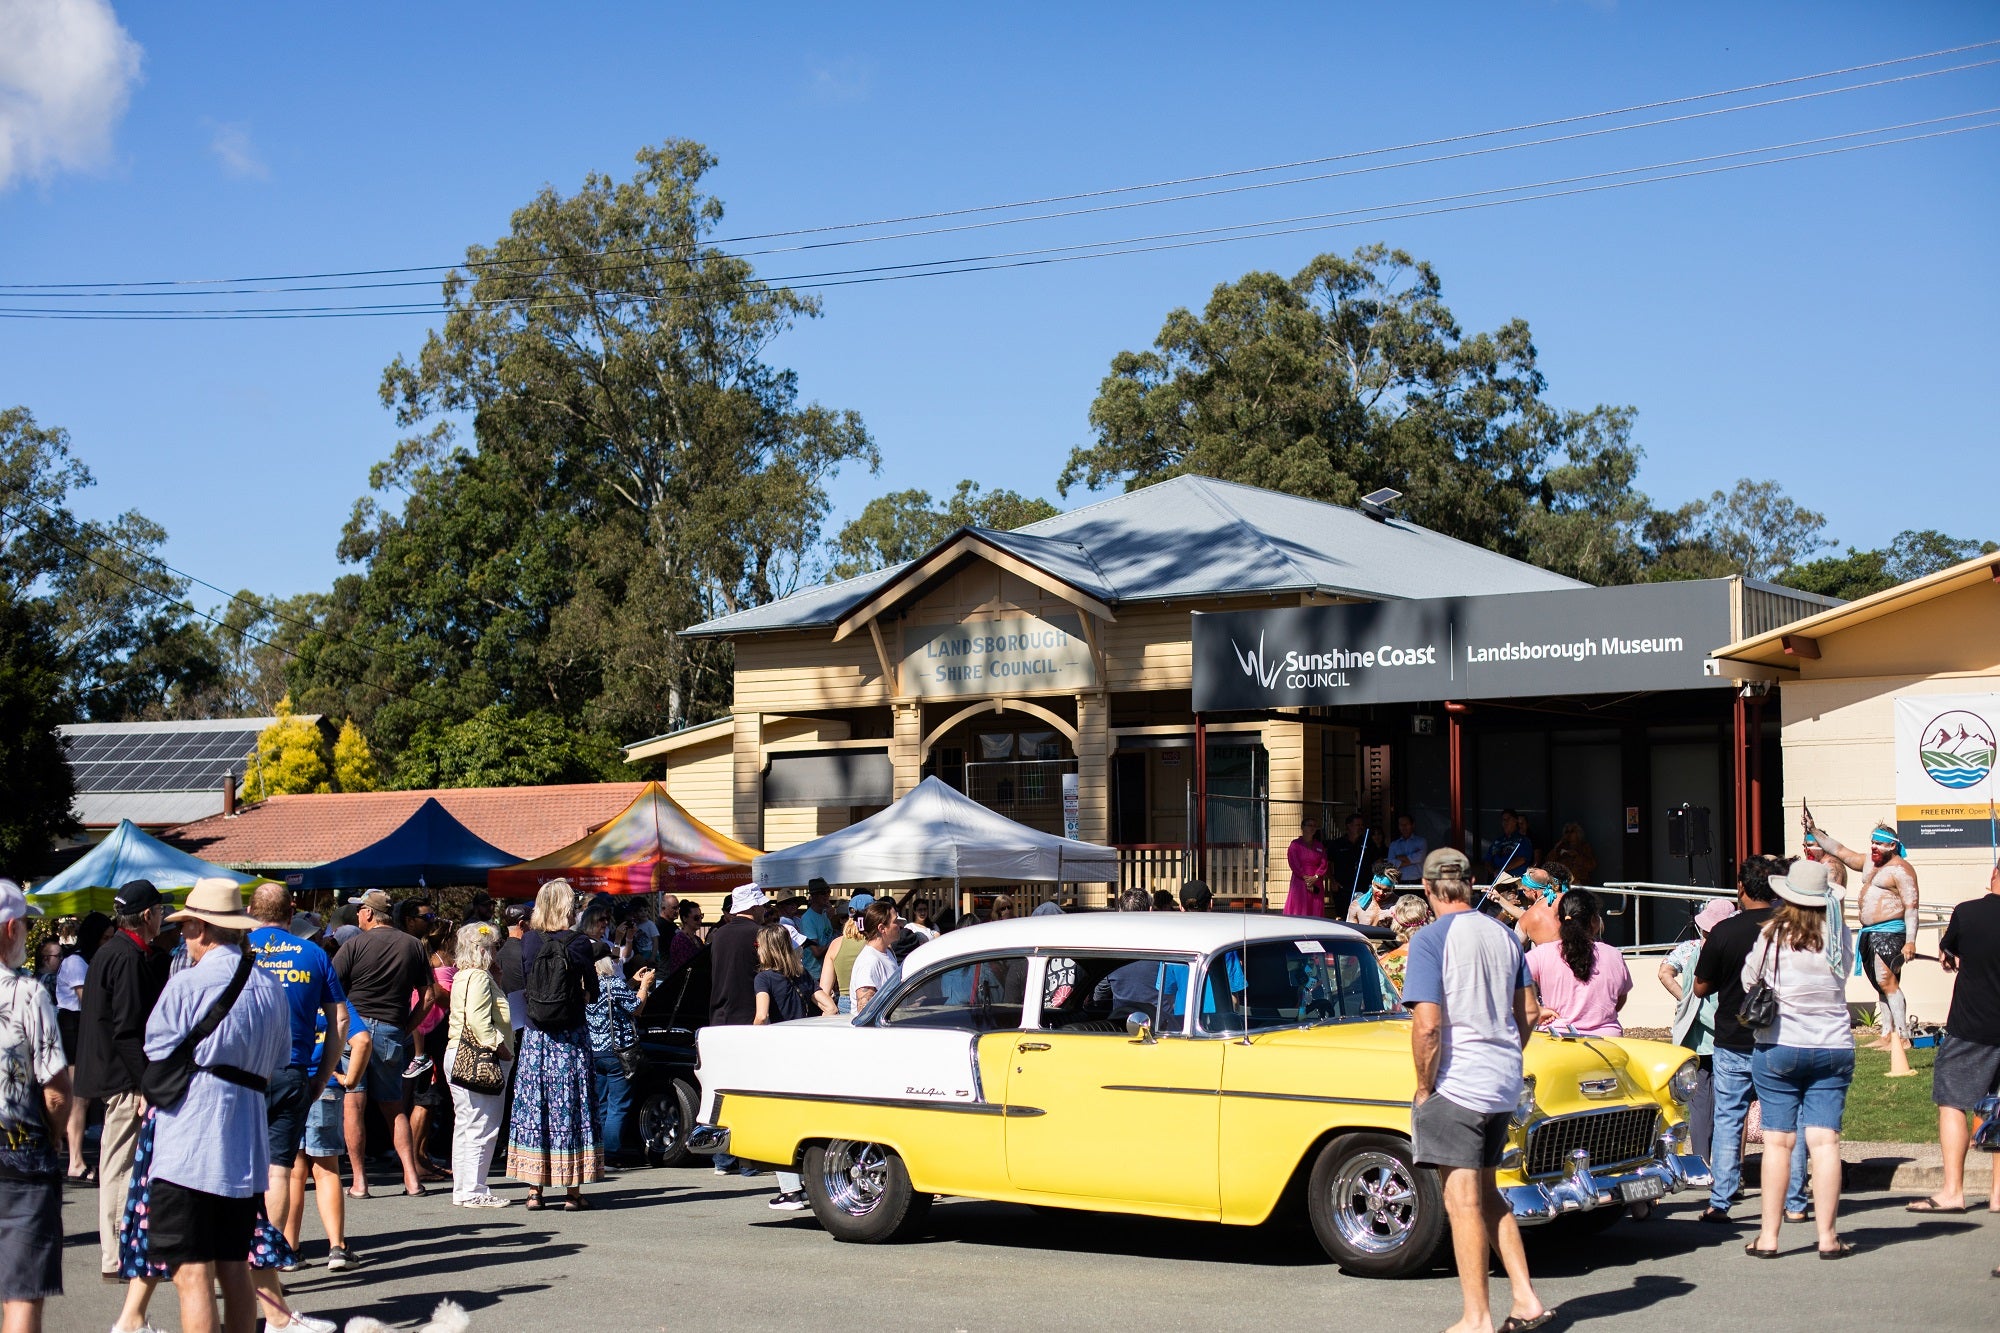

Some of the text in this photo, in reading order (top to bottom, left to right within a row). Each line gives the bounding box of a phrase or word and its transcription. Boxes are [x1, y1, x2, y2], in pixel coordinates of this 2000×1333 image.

[927, 631, 1068, 659] LANDSBOROUGH
[1467, 636, 1683, 662] Landsborough Museum
[1286, 644, 1436, 672] Sunshine Coast
[935, 664, 983, 683] SHIRE
[1286, 672, 1350, 689] COUNCIL
[1968, 807, 1986, 815] Open
[257, 959, 293, 969] Kendall
[269, 969, 311, 984] TON
